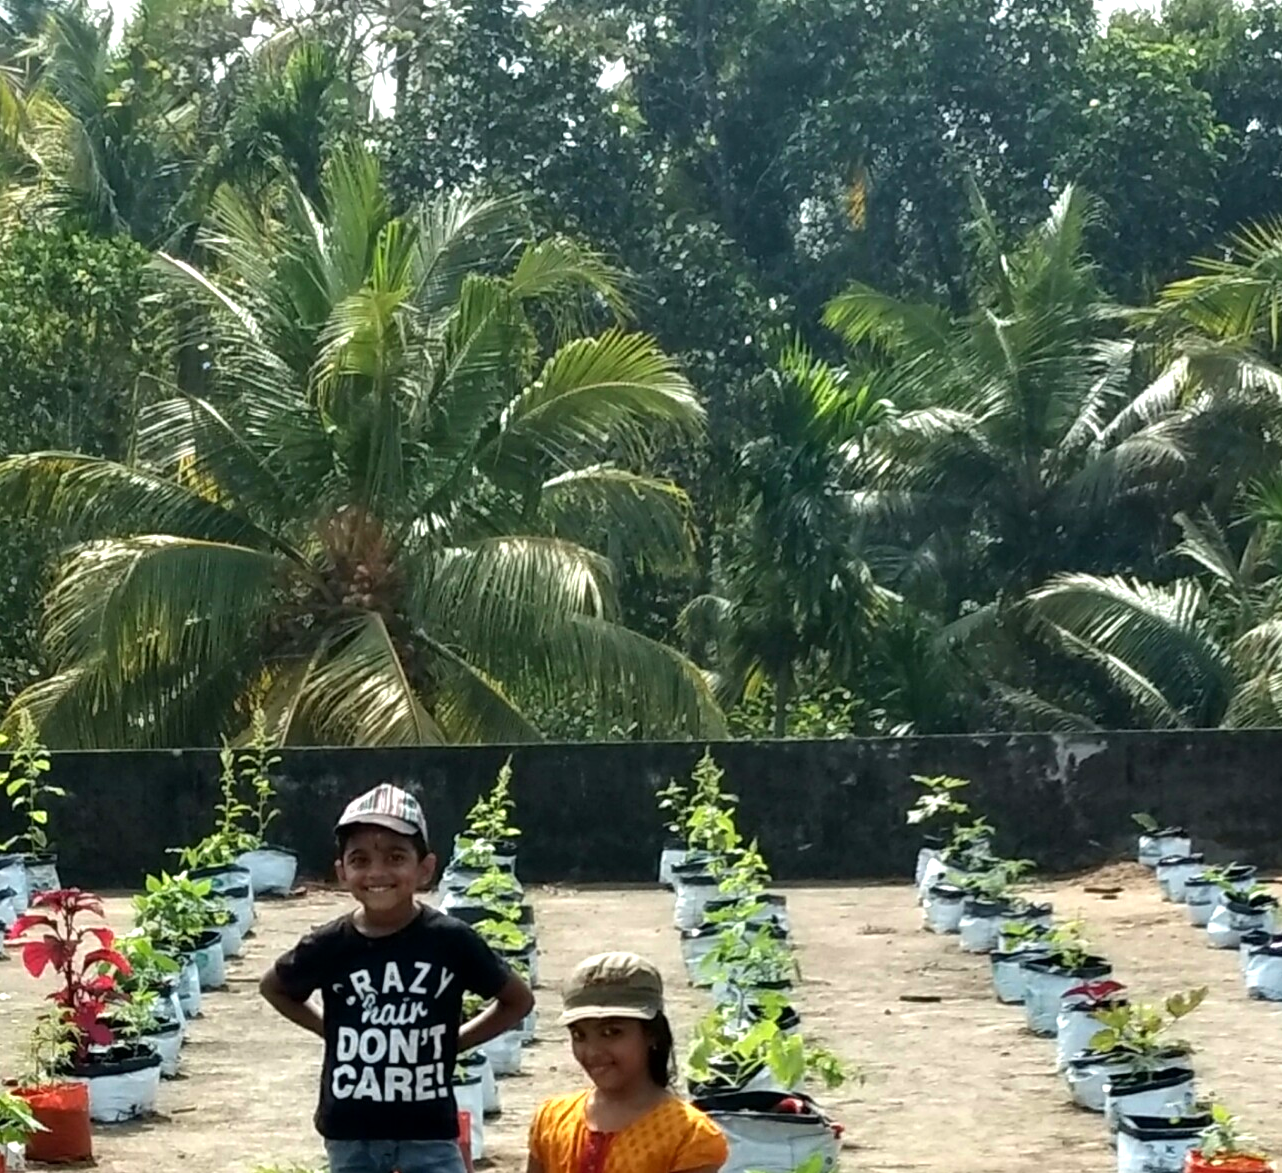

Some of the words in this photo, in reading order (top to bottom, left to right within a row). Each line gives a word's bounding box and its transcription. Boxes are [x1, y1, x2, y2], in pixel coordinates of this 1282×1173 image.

[361, 993, 428, 1026] hair
[336, 1023, 446, 1064] DON'T
[331, 1062, 448, 1102] CARE!
